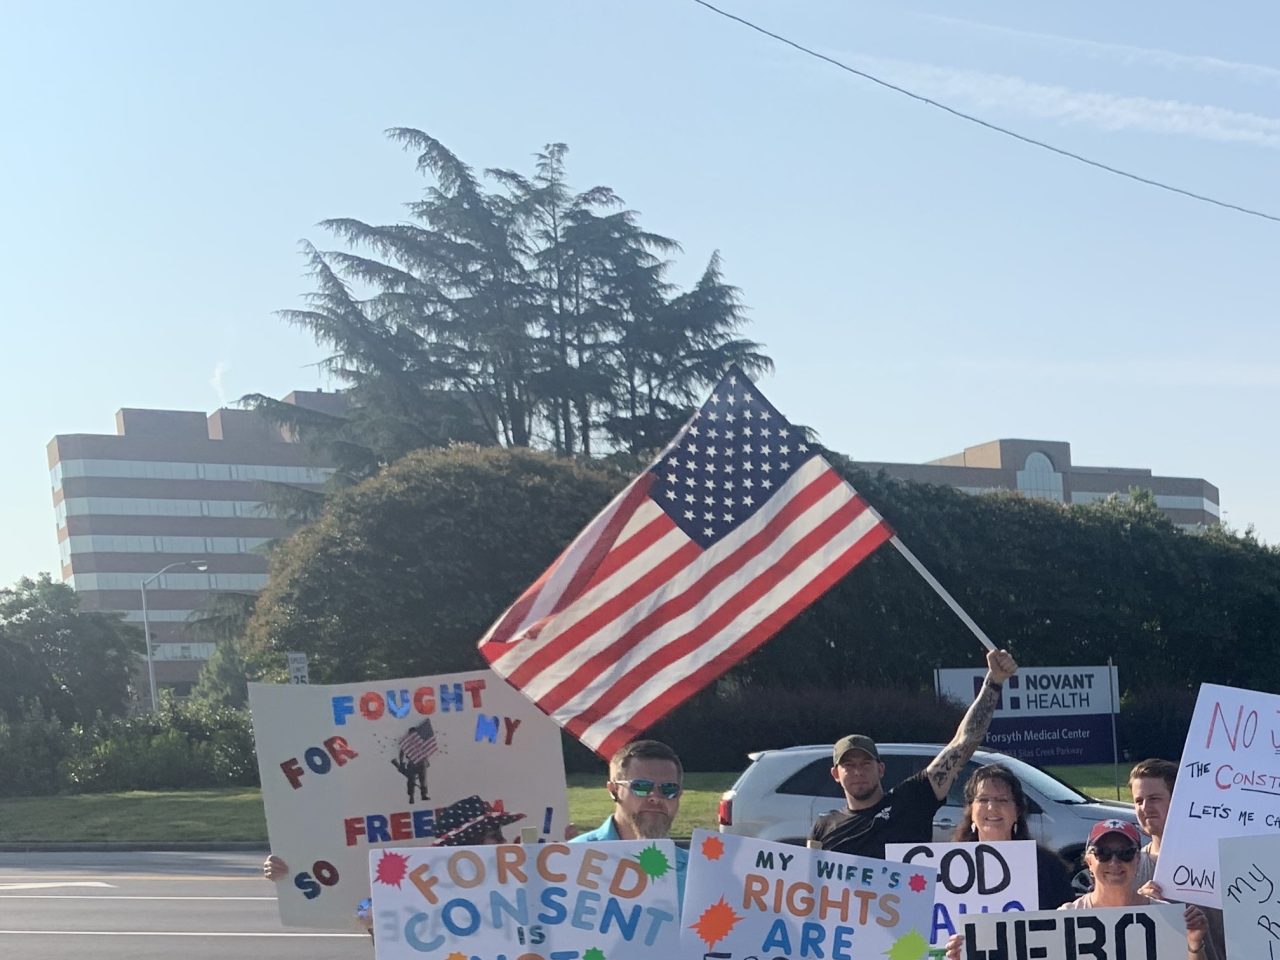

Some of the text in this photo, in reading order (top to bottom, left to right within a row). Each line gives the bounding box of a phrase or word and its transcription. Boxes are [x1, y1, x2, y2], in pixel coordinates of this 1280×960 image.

[1025, 674, 1095, 690] NOVANT
[1026, 692, 1090, 709] HEALTH
[332, 679, 486, 726] FOUGHT
[986, 728, 1090, 744] Forsyth Medical Center
[1206, 702, 1258, 752] NO
[280, 713, 521, 790] FOR MY
[1186, 761, 1211, 778] THE
[1239, 811, 1254, 826] ME
[294, 860, 340, 900] SO
[408, 845, 648, 905] FORCED
[755, 850, 901, 888] MY WIFE'S
[1172, 865, 1216, 889] OWN
[404, 887, 674, 952] CONSENT
[742, 874, 902, 927] RIGHTS
[517, 925, 546, 945] IS
[761, 918, 854, 960] ARE
